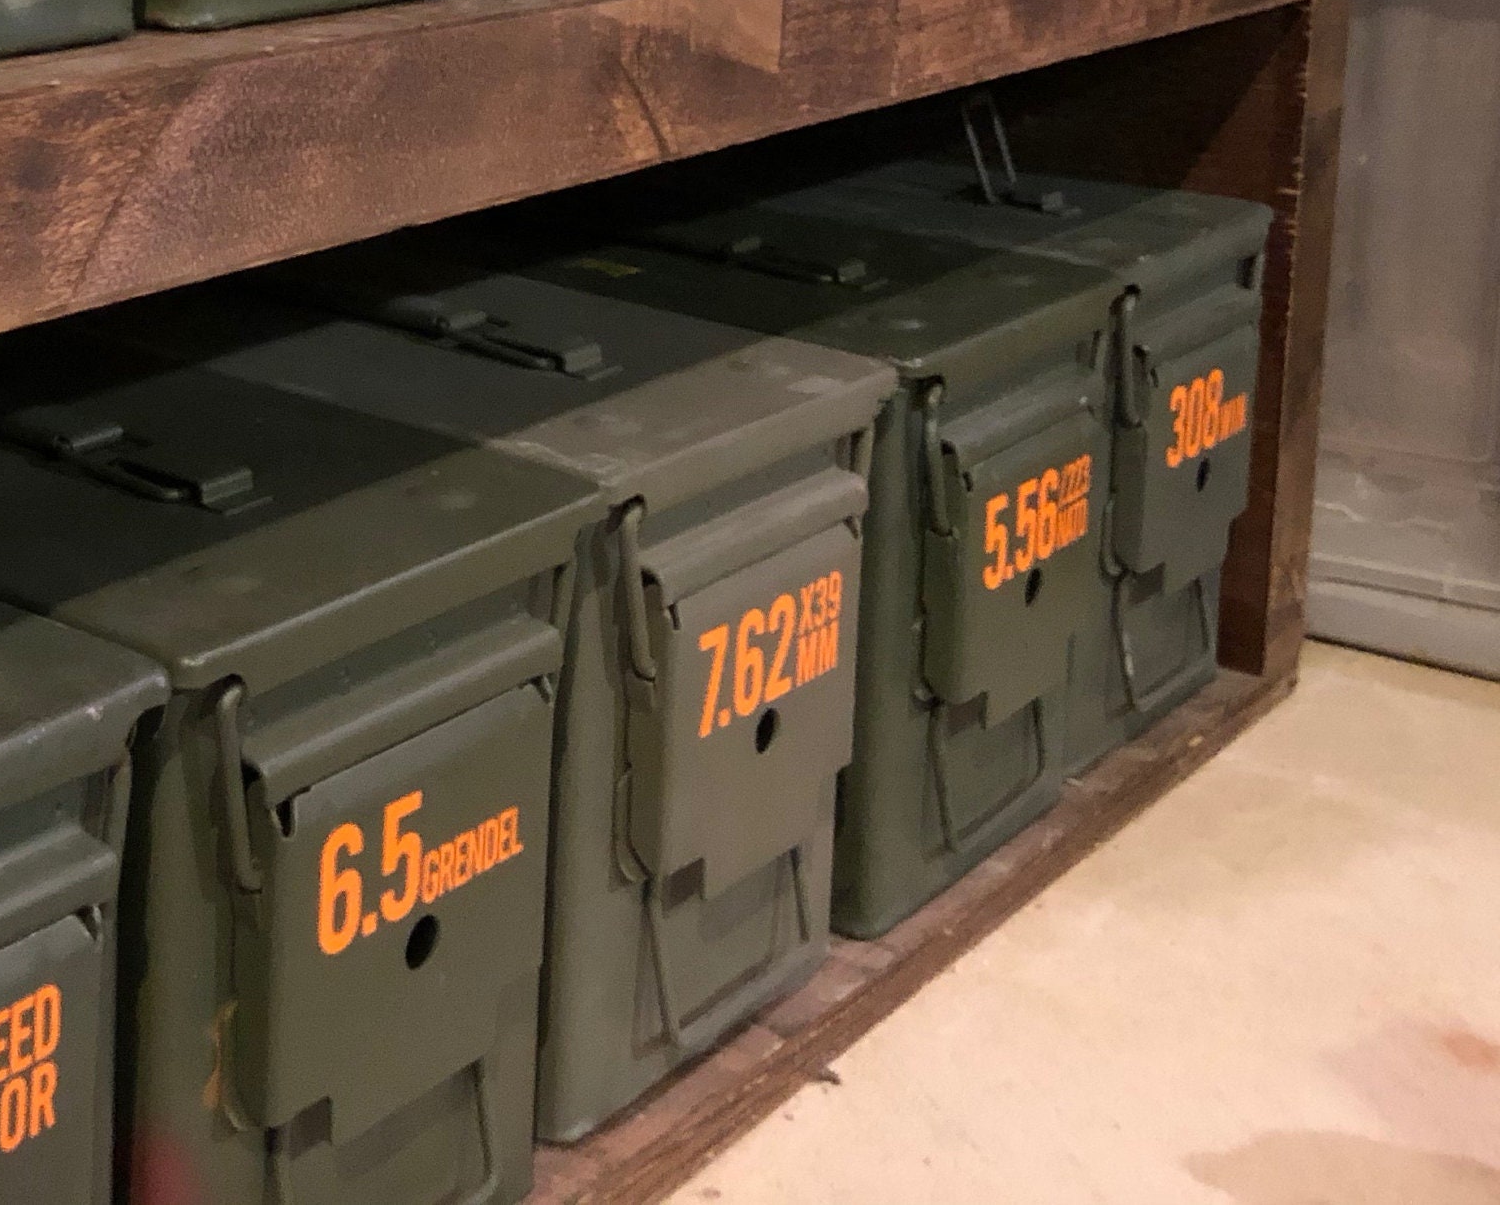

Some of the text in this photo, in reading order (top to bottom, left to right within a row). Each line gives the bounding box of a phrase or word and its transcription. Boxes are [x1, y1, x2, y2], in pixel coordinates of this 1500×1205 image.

[1165, 368, 1224, 468] 308
[982, 467, 1060, 590] 5.56
[698, 593, 797, 737] 7.62
[795, 622, 839, 689] MM
[316, 790, 524, 956] 6.5 GRENDEL
